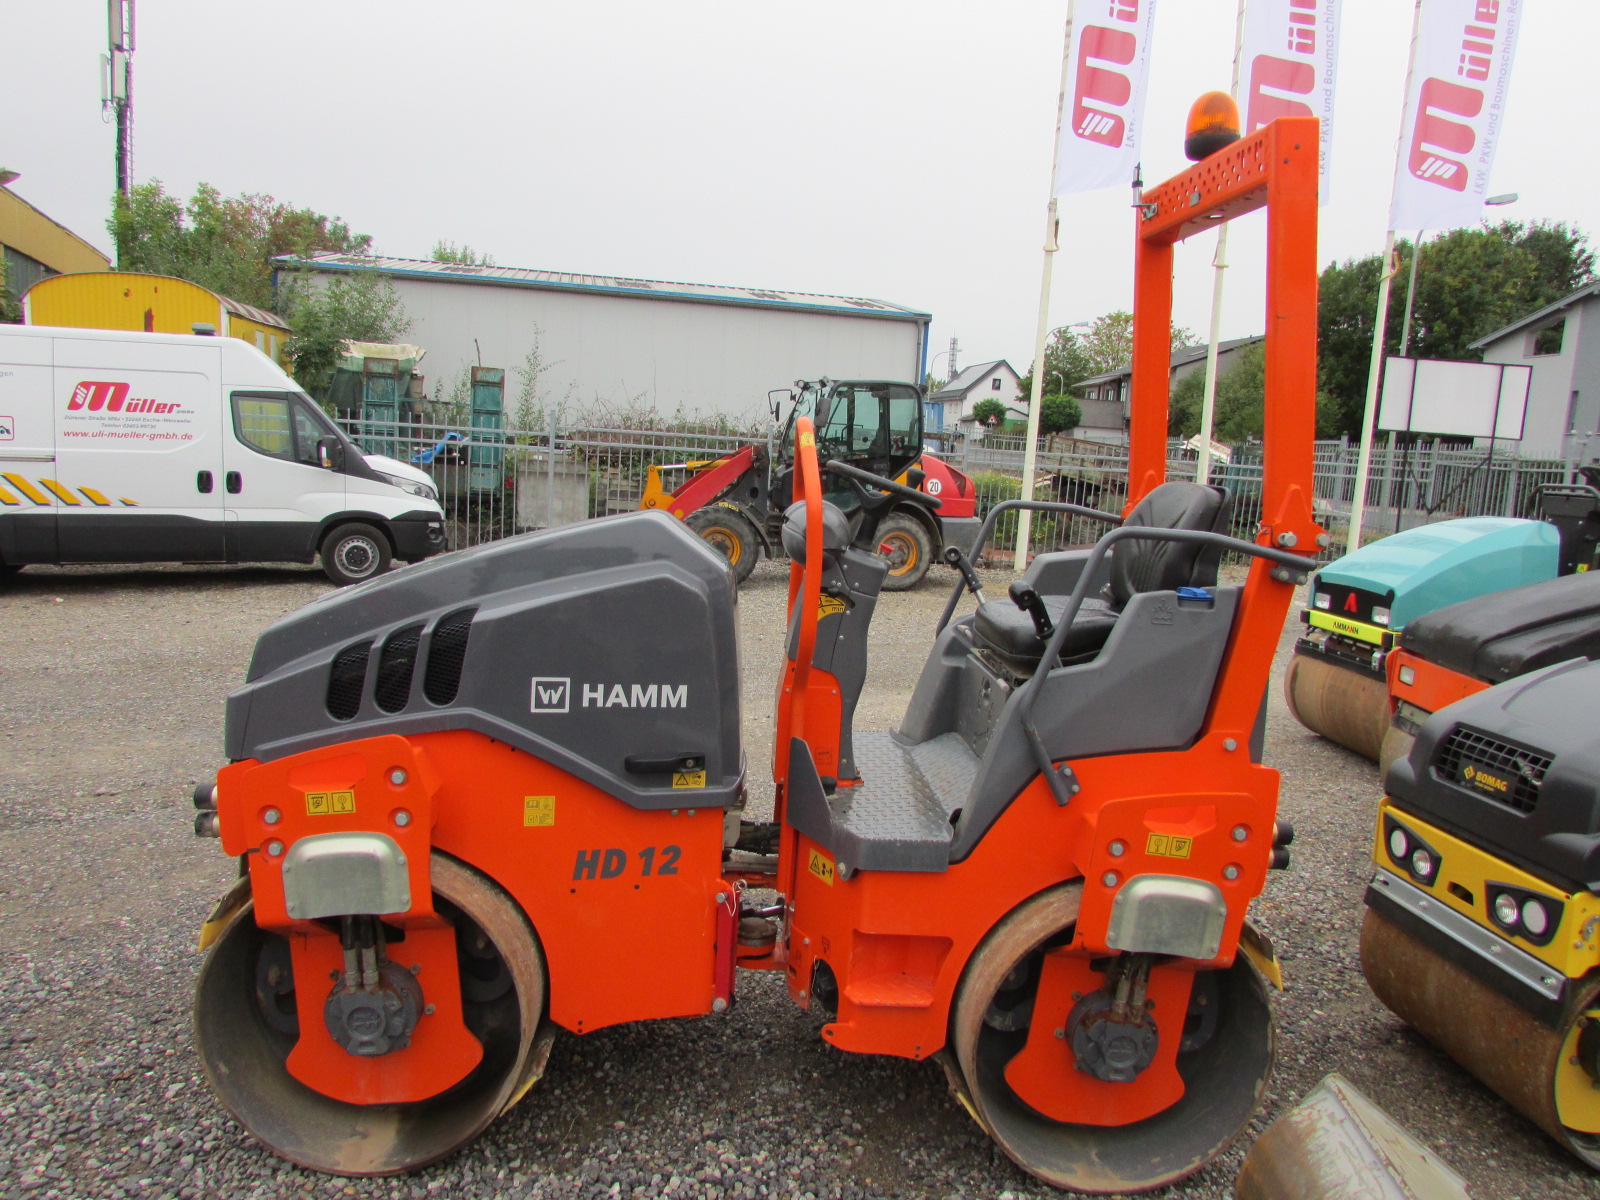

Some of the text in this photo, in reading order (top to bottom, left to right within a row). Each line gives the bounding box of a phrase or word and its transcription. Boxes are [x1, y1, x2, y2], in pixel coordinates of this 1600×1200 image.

[1323, 89, 1332, 112] und
[1320, 116, 1330, 143] PKW
[1479, 138, 1493, 164] PKW
[1486, 113, 1498, 135] und
[1415, 156, 1457, 179] uli
[67, 381, 181, 414] Müller
[63, 430, 193, 441] www.uli-mueller-gmbh.de
[929, 481, 939, 493] 20
[1333, 621, 1359, 635] AMMANN
[582, 683, 688, 708] HAMM
[1475, 771, 1509, 792] BOMAG
[572, 845, 682, 881] HD 12
